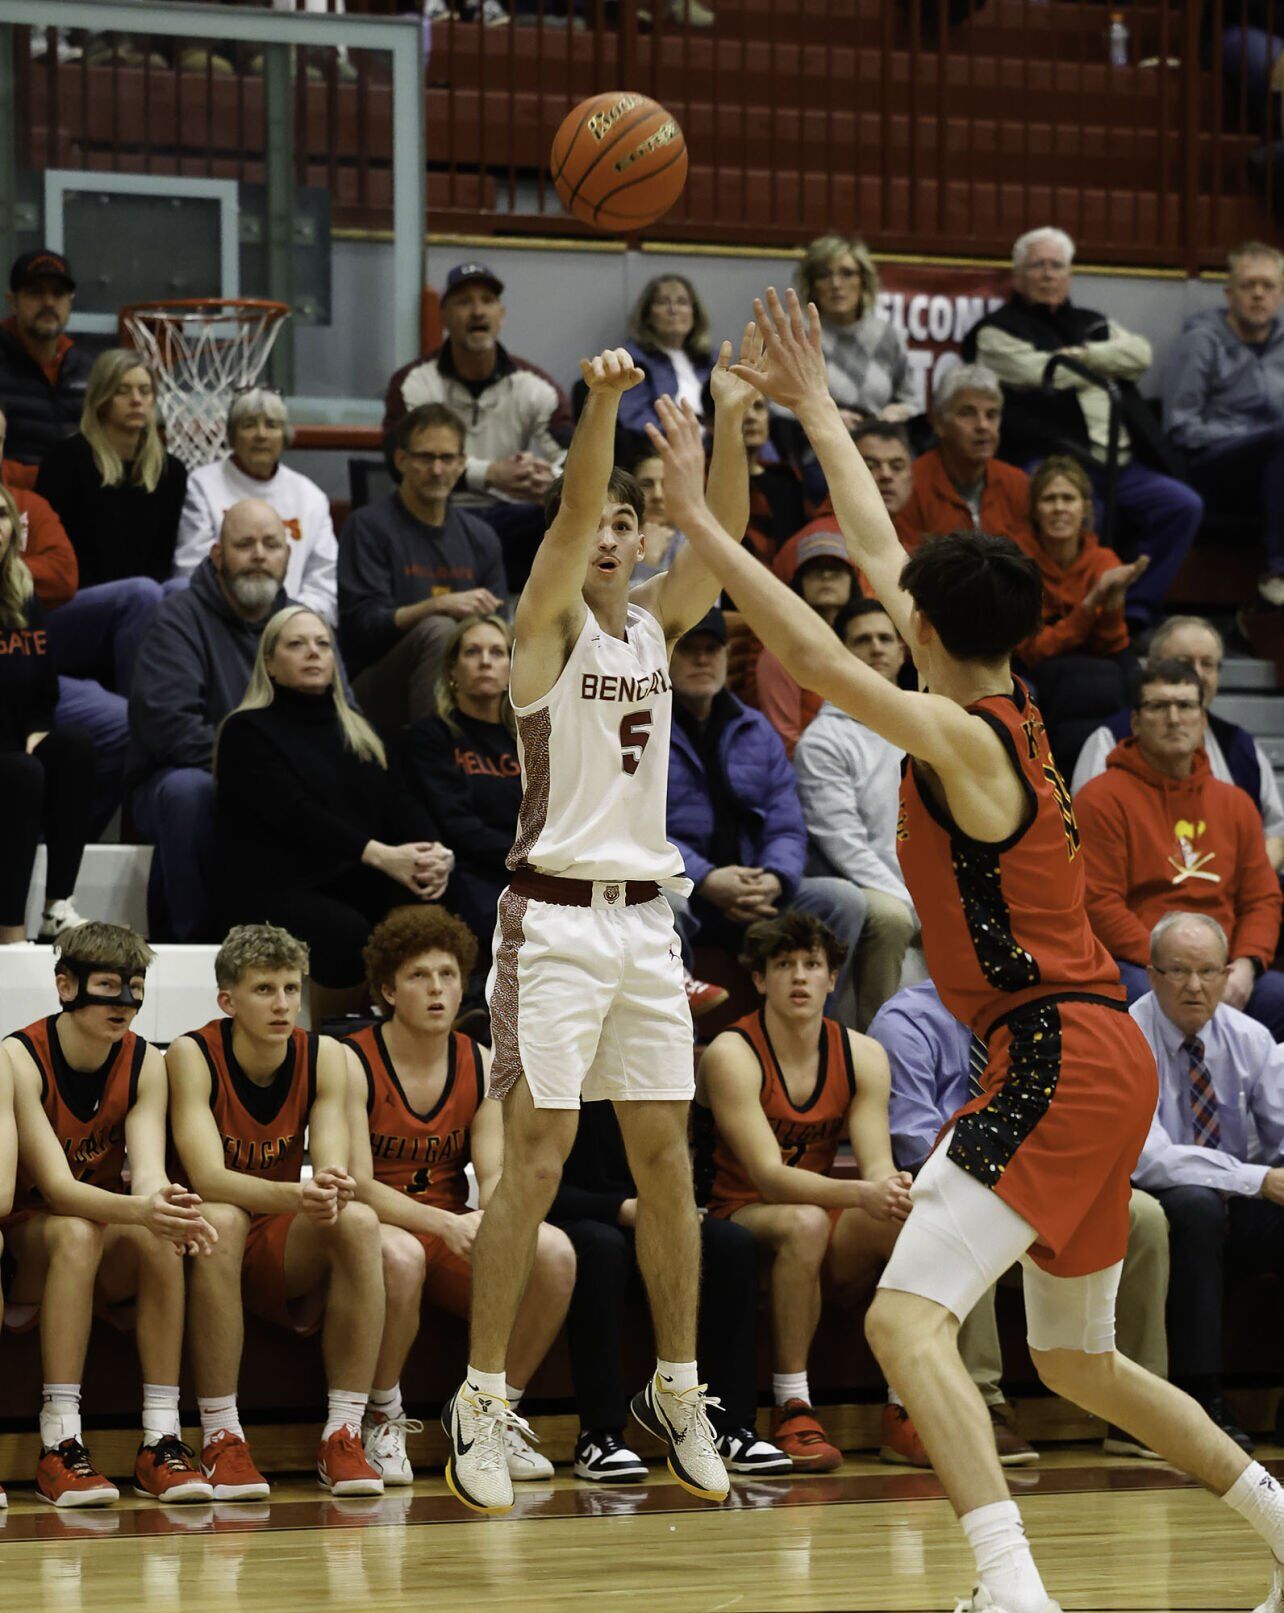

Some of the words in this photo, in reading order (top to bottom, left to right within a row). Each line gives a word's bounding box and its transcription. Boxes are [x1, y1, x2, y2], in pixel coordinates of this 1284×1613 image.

[875, 292, 1004, 342] ELCOM
[581, 667, 673, 703] BENGAL
[618, 708, 653, 777] 5
[370, 1127, 467, 1163] HELLGAT
